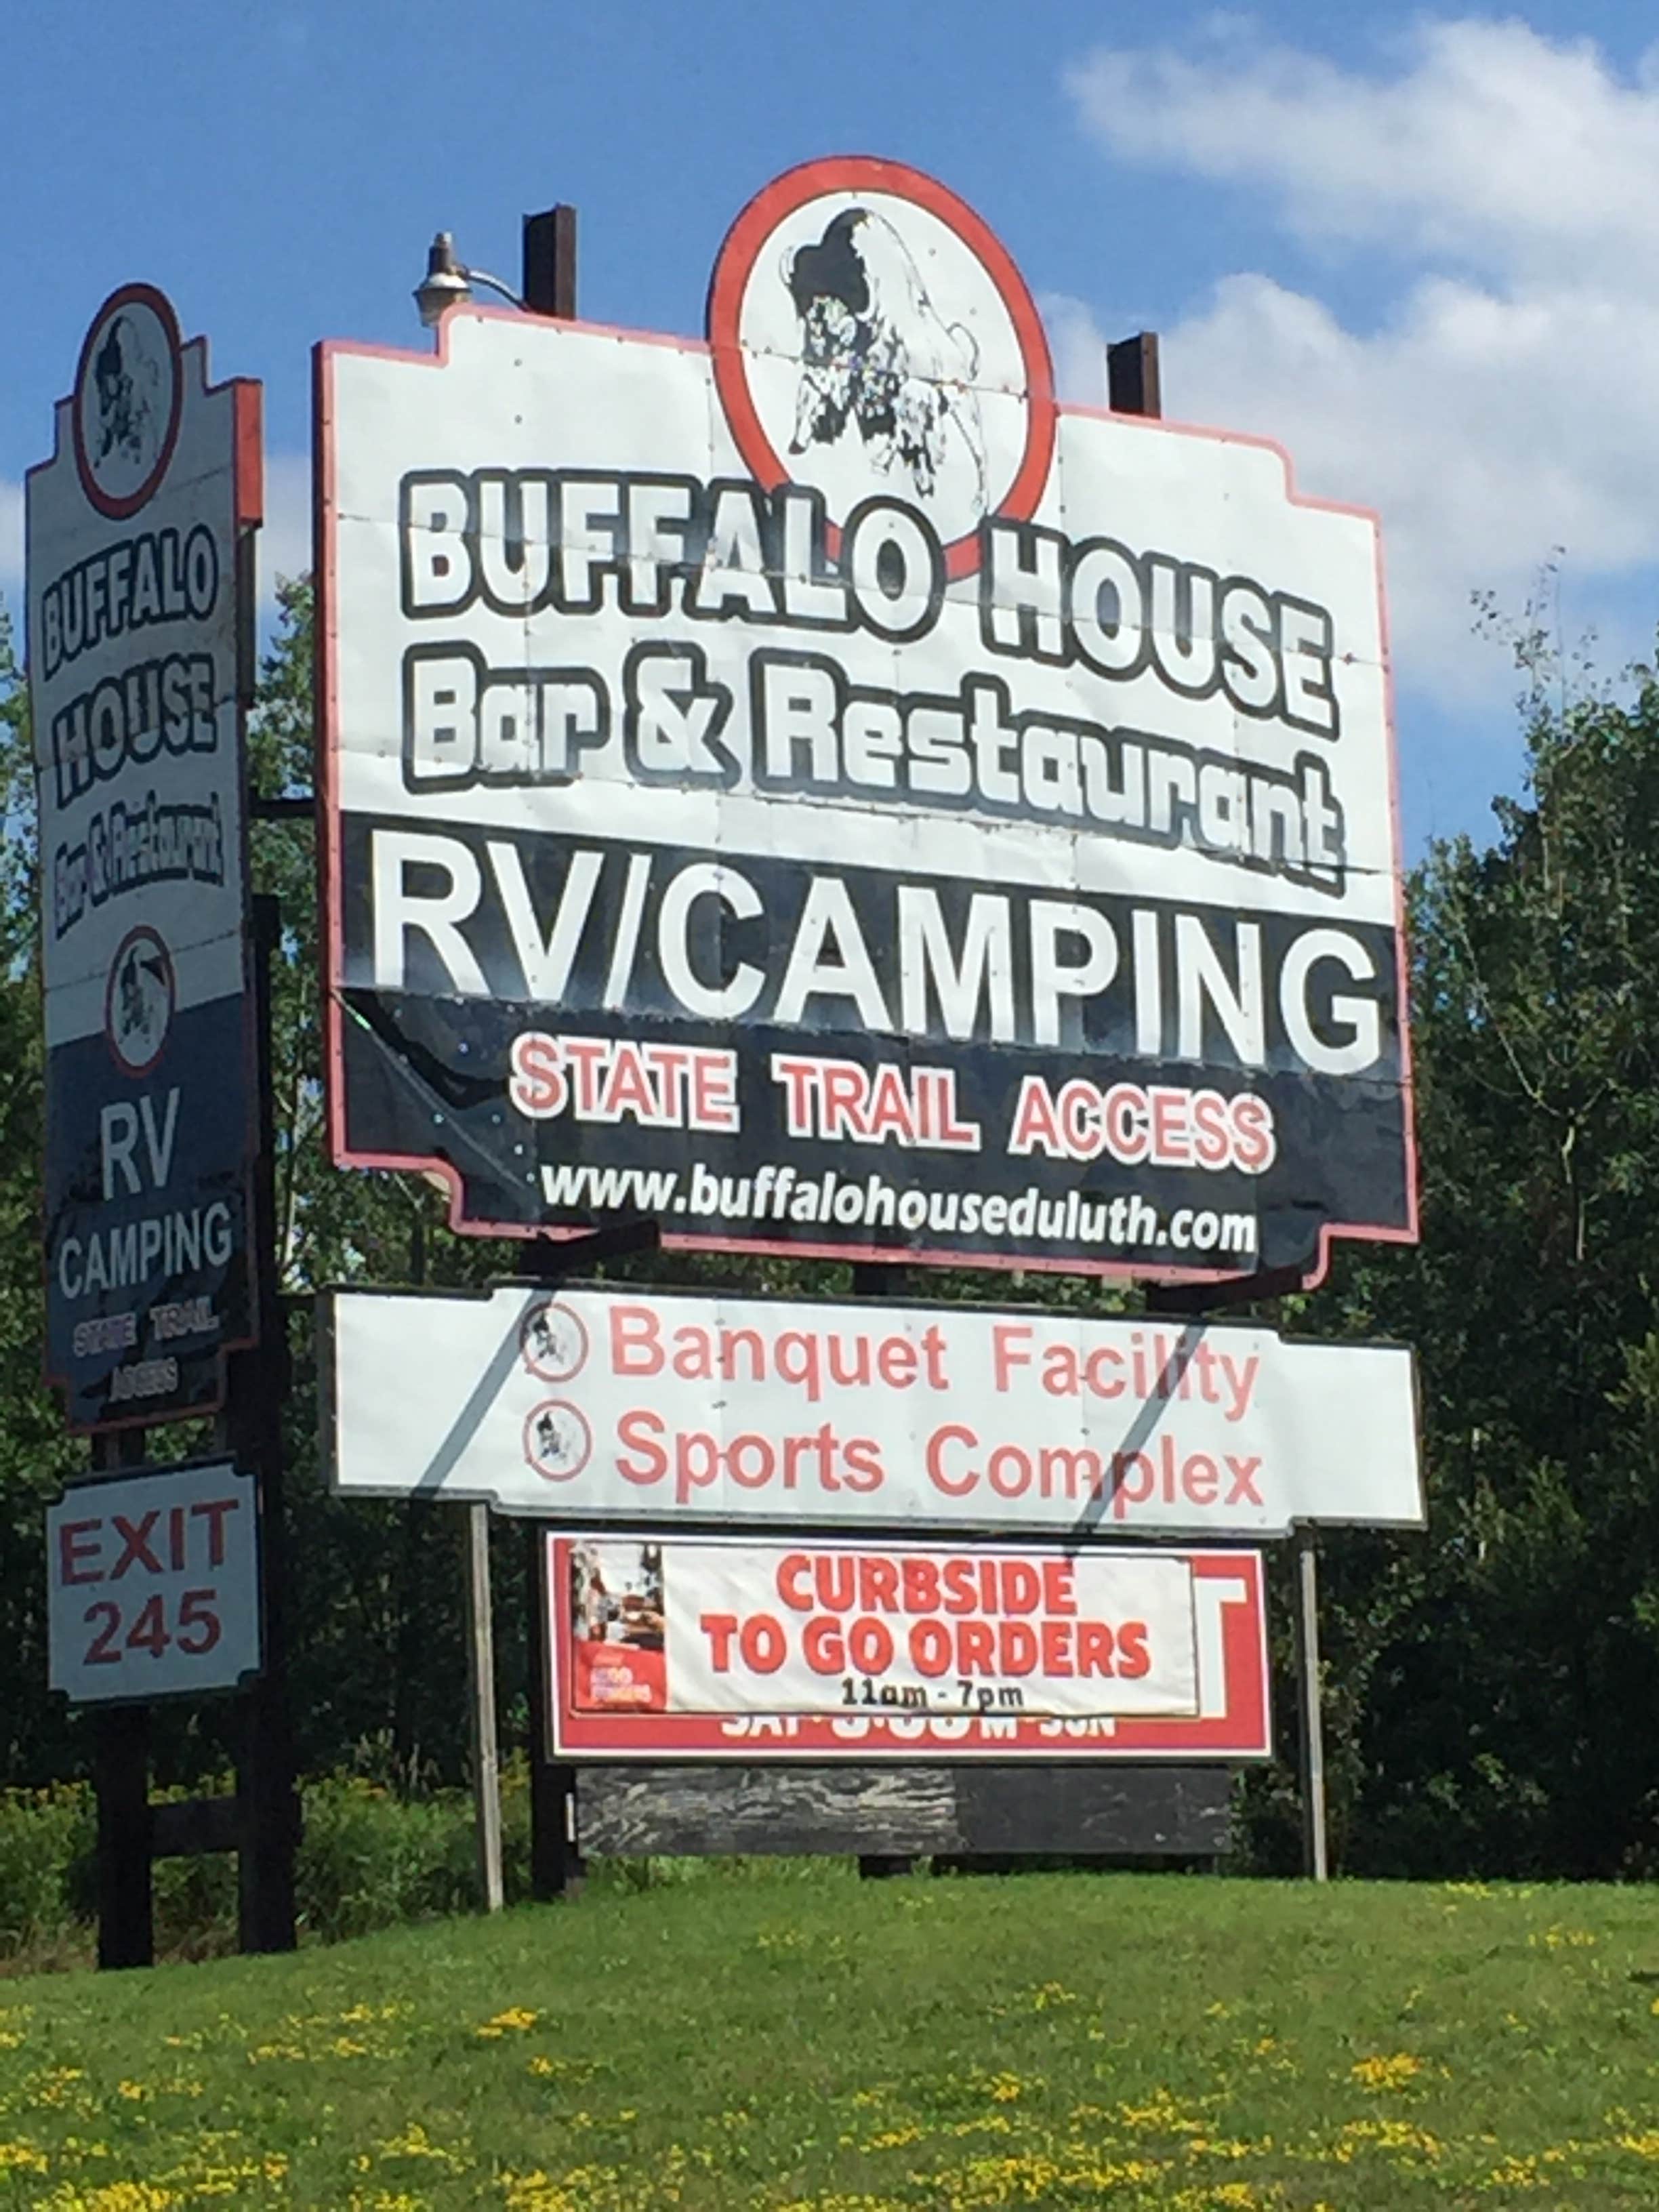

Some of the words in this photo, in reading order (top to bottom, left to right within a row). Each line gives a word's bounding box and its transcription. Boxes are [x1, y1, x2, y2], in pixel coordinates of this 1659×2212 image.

[42, 524, 220, 680] BUFFALO
[399, 468, 947, 644] BUFFALO
[980, 514, 1340, 742] HOUSE
[52, 653, 218, 811] HOUSE
[403, 640, 611, 794] Bar
[623, 640, 742, 789] &
[749, 647, 1347, 899] Restaurant
[371, 829, 1380, 1075] RV/CAMPING
[101, 1087, 180, 1201] RV
[510, 1031, 741, 1132] STATE
[772, 1054, 981, 1152] TRAIL
[1008, 1075, 1276, 1174] ACCESS
[60, 1202, 232, 1299] CAMPING
[541, 1163, 1256, 1252] www.buffalohouseduluth.com
[150, 1296, 220, 1340] TRAIL
[609, 1305, 949, 1401] Banquet
[991, 1325, 1260, 1421] Facility
[616, 1410, 885, 1505] Sports
[926, 1425, 1265, 1519] Complex
[60, 1499, 239, 1586] EXIT
[777, 1554, 1078, 1615] CURBSIDE
[83, 1589, 221, 1666] 245
[700, 1614, 786, 1675] TO
[803, 1616, 894, 1677] GO
[909, 1618, 1151, 1678] ORDERS
[842, 1677, 927, 1708] 11am
[957, 1680, 1023, 1714] 7pm
